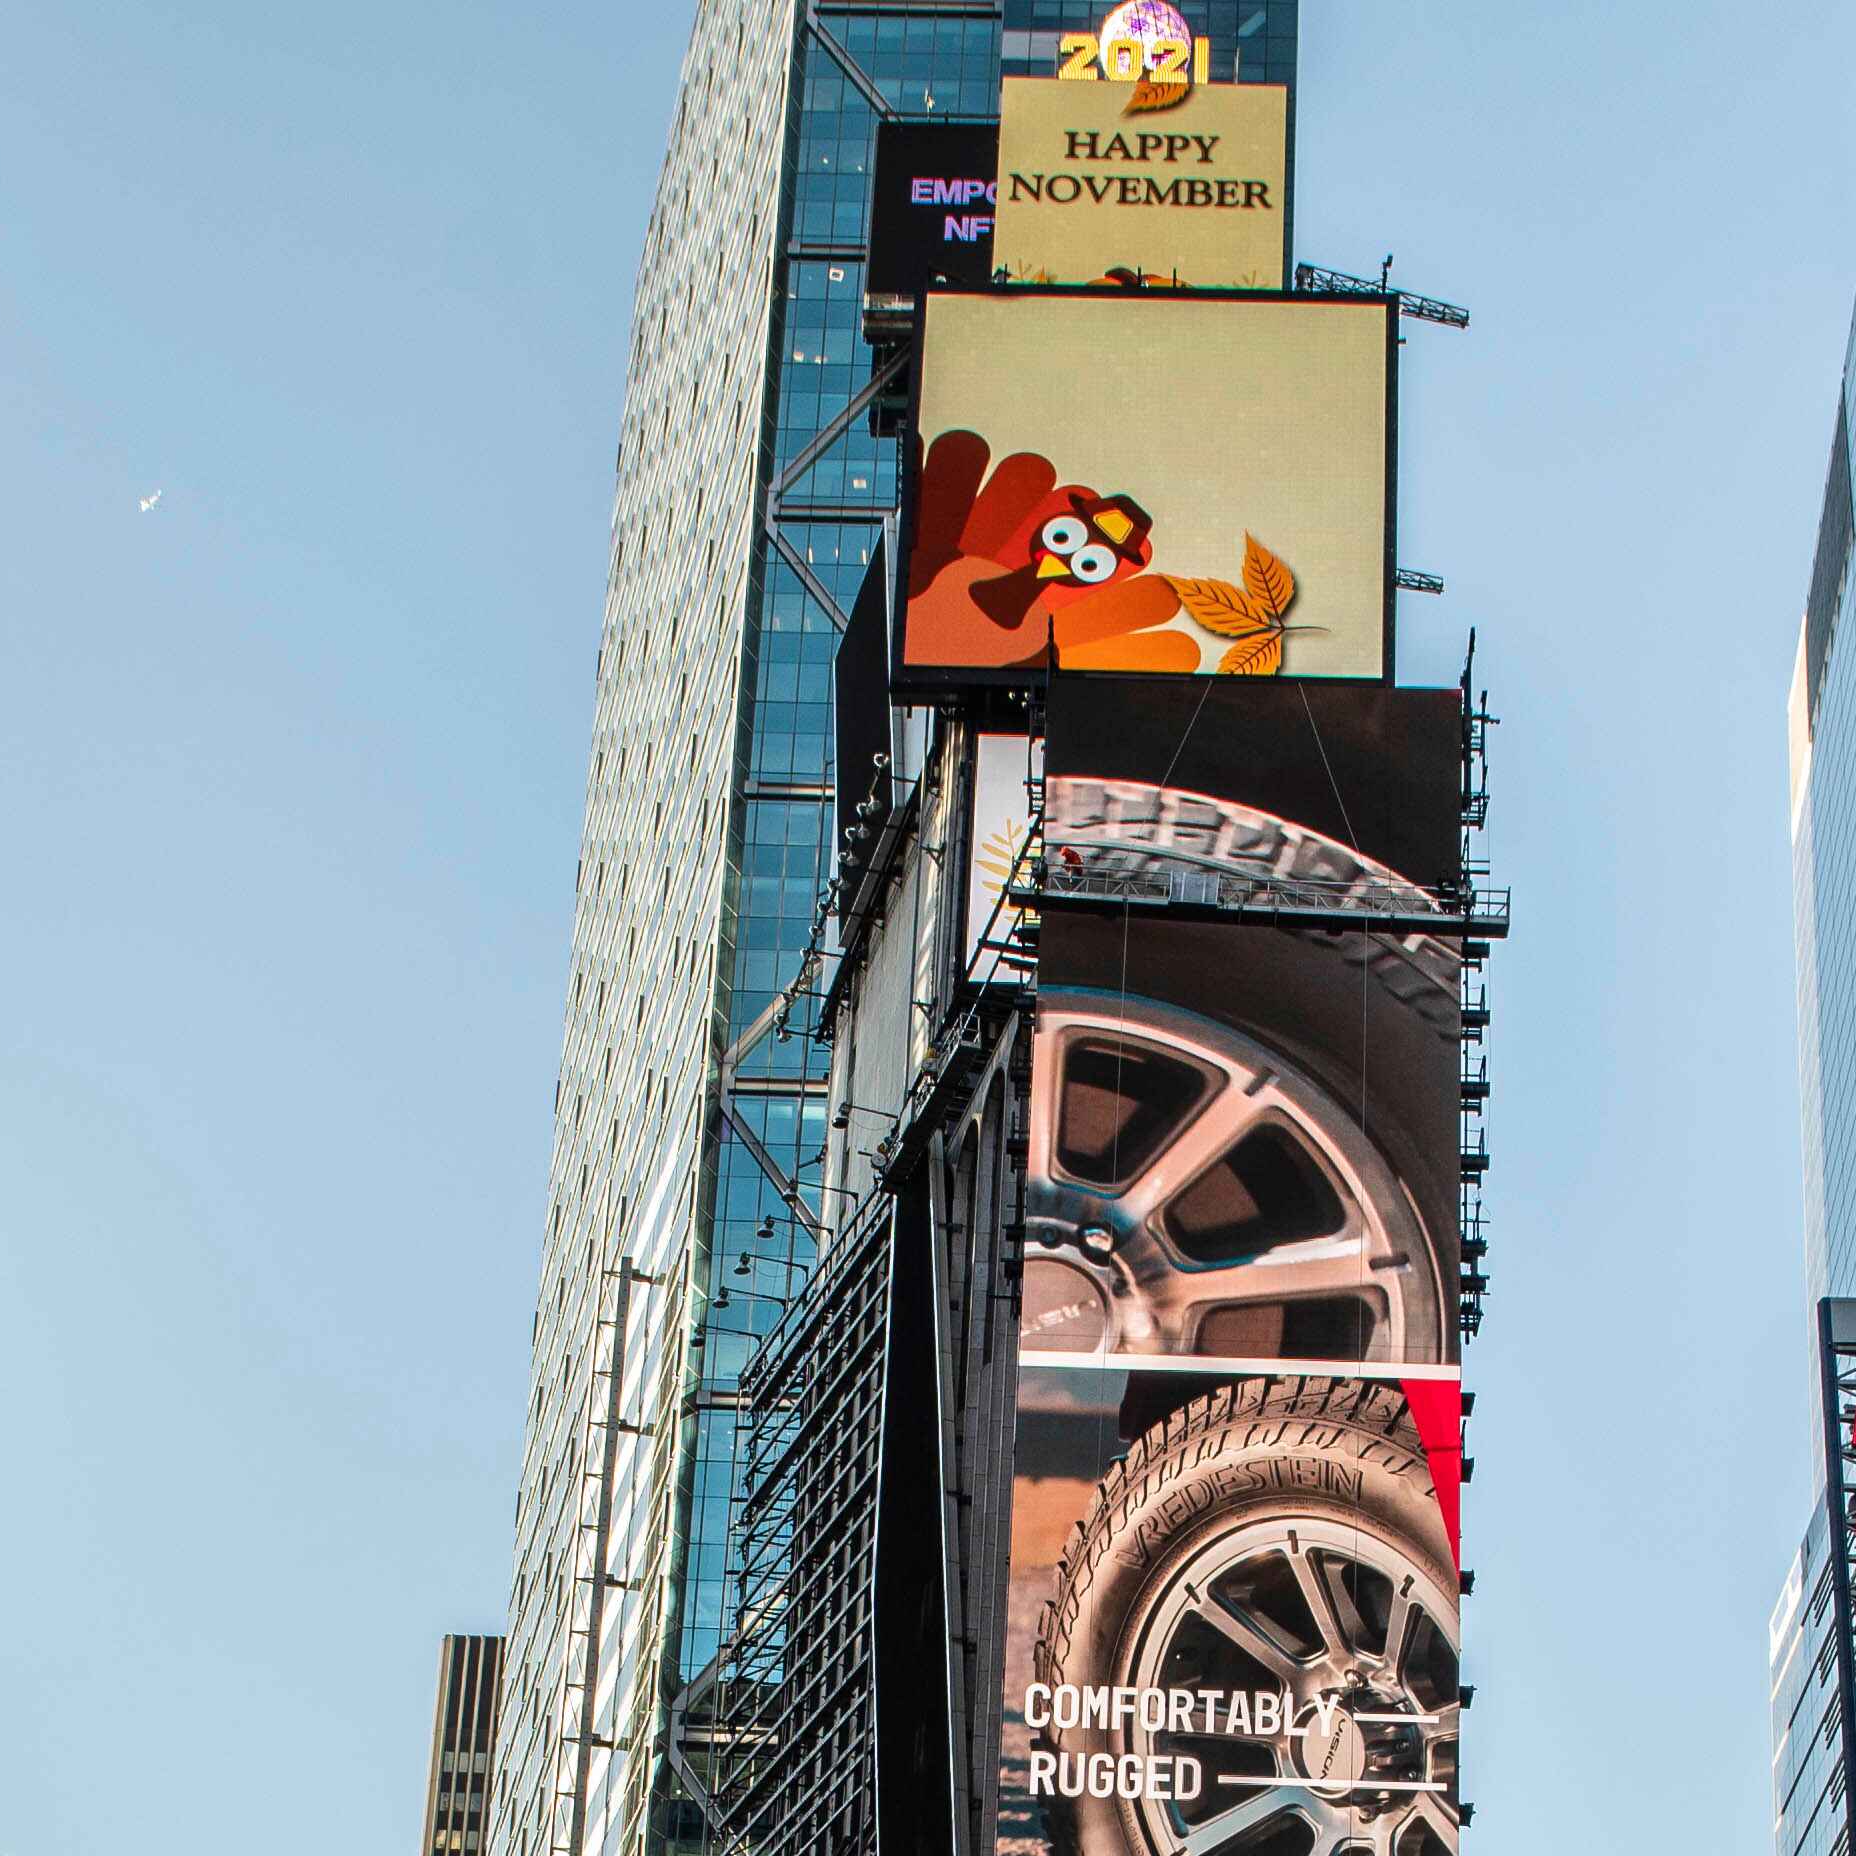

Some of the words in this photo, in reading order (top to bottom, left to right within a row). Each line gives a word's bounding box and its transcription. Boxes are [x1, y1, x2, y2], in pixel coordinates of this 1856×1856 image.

[1058, 32, 1210, 85] 2021
[1064, 128, 1221, 163] HAPPY
[1008, 172, 1273, 209] NOVEMBER
[943, 214, 994, 242] NF
[1024, 1683, 1341, 1737] COMFORTABLY
[1029, 1750, 1202, 1801] RUGGED
